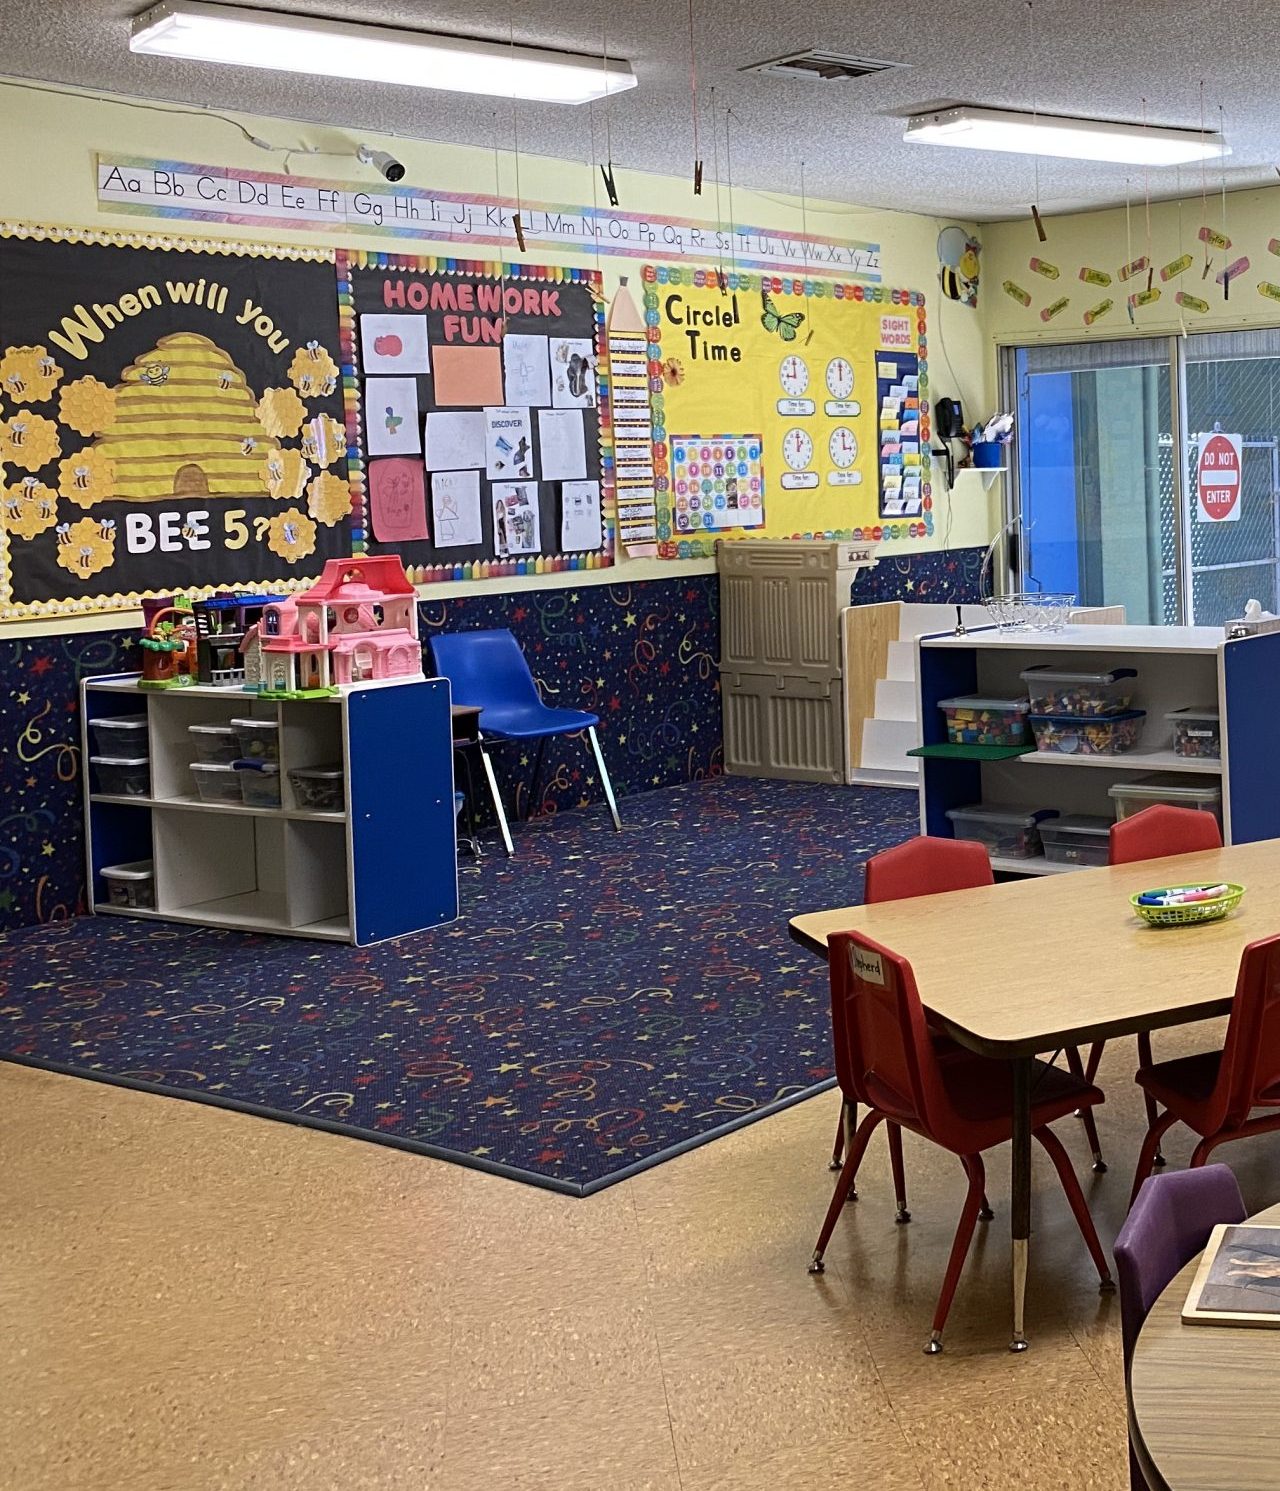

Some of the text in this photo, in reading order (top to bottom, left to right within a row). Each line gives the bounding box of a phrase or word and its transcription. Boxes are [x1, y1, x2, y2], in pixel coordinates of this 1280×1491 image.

[103, 166, 140, 193] Aa
[154, 170, 184, 196] Bb
[197, 176, 226, 201] Cc
[239, 181, 268, 205] Dd
[282, 186, 304, 208] Ee
[318, 190, 339, 212] Ff
[354, 193, 383, 225] Gg
[395, 196, 418, 220] Hh
[430, 200, 440, 222] Ii
[454, 204, 472, 234] Jj
[486, 206, 507, 228] Kk
[546, 213, 575, 234] Mm
[582, 217, 602, 236] Nn
[608, 220, 629, 239] Oo
[640, 222, 656, 251] Pp
[663, 226, 684, 253] Qq
[691, 228, 705, 246] Rr
[716, 232, 729, 250] Ss
[738, 234, 750, 251] Tt
[758, 237, 774, 255] Uu
[782, 240, 795, 256] Vv
[801, 242, 822, 260] Ww
[828, 246, 841, 262] Xx
[848, 248, 860, 271] Yy
[866, 250, 878, 268] Zz
[384, 280, 562, 316] HOMEWORK
[48, 279, 290, 360] When will you
[444, 315, 504, 344] FUN
[882, 320, 908, 331] SIGHT
[686, 330, 741, 362] Time
[881, 334, 911, 344] WORDS
[491, 420, 523, 429] DISCOVER
[1204, 452, 1234, 466] DO NOT
[1206, 490, 1230, 503] ENTER
[126, 510, 211, 554] BEE
